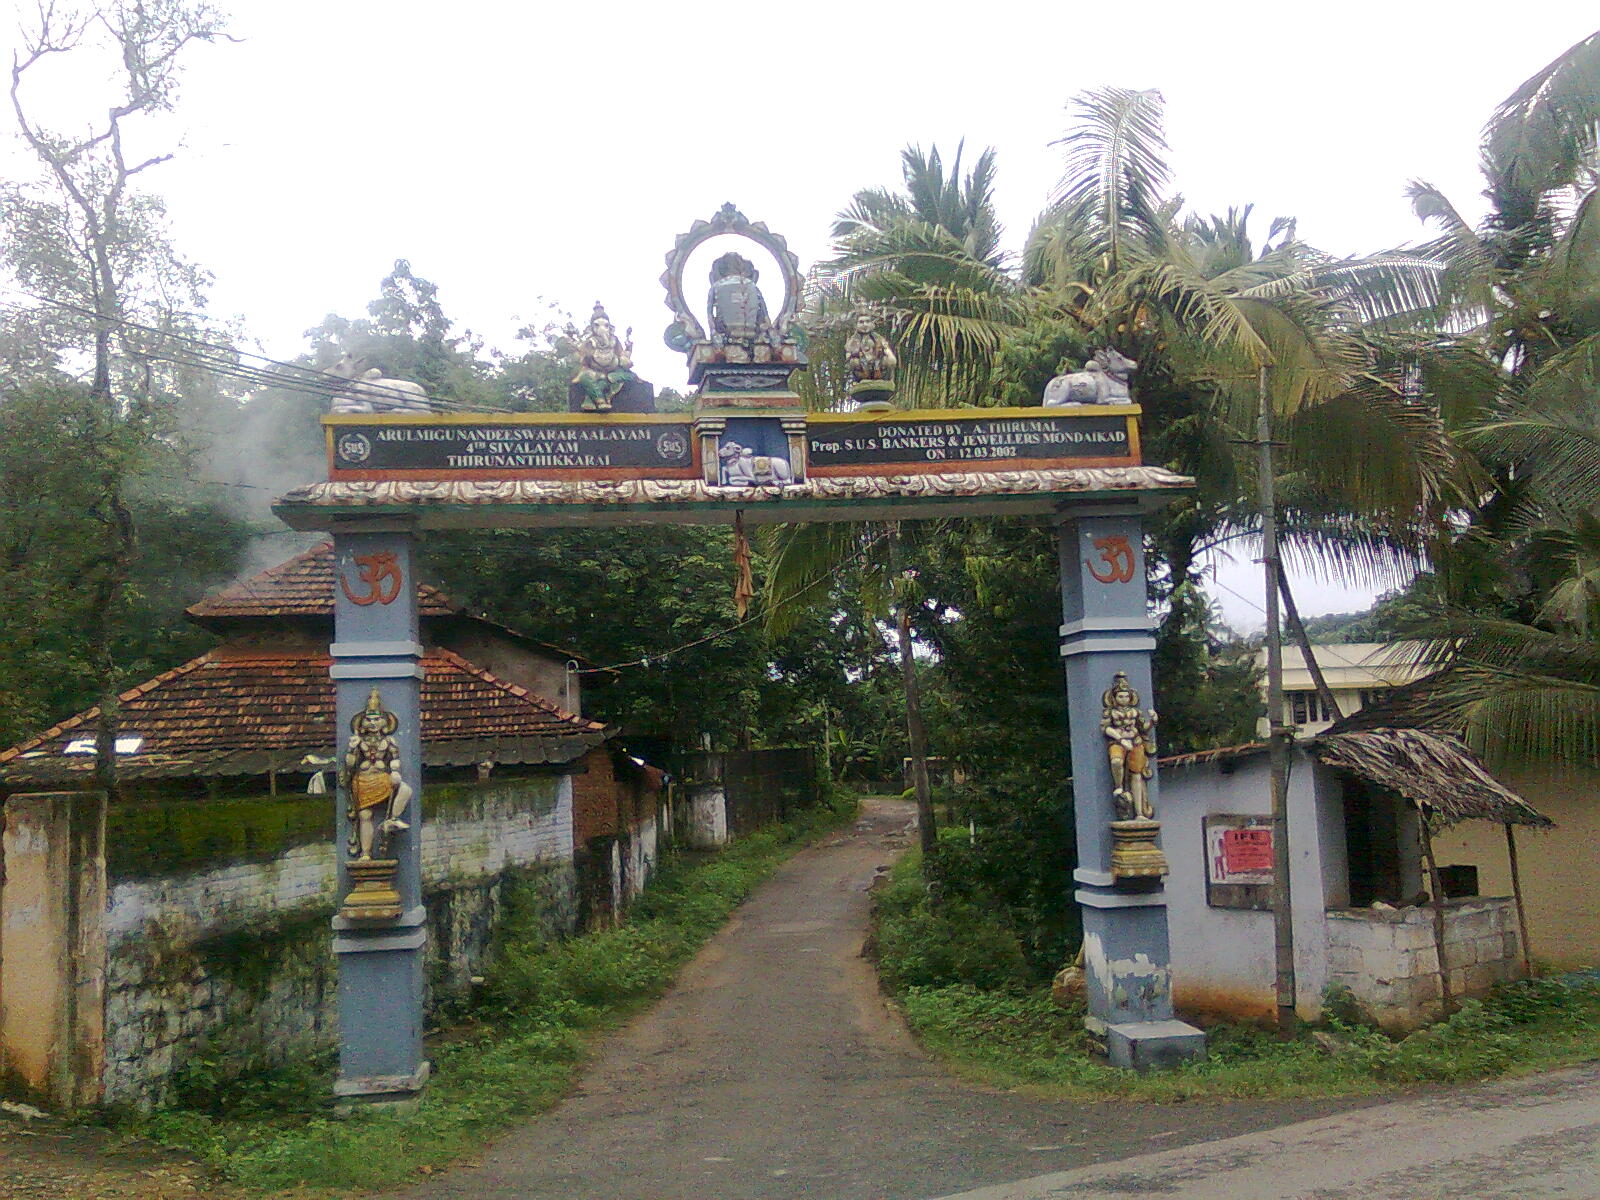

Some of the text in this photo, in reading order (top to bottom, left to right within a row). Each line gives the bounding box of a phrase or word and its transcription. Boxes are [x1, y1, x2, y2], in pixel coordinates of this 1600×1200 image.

[376, 429, 651, 441] ARULMIGU NANDEESWARAR AALAYAM
[878, 426, 942, 438] DONATED
[989, 421, 1059, 433] THIRUMAL
[883, 436, 945, 449] BANKERS
[962, 433, 1040, 446] JEWELLERS
[1043, 431, 1125, 444] MONDAIKAD
[489, 441, 579, 453] SIVALAYAM
[447, 455, 610, 467] THIRUNANTHIKKARAI
